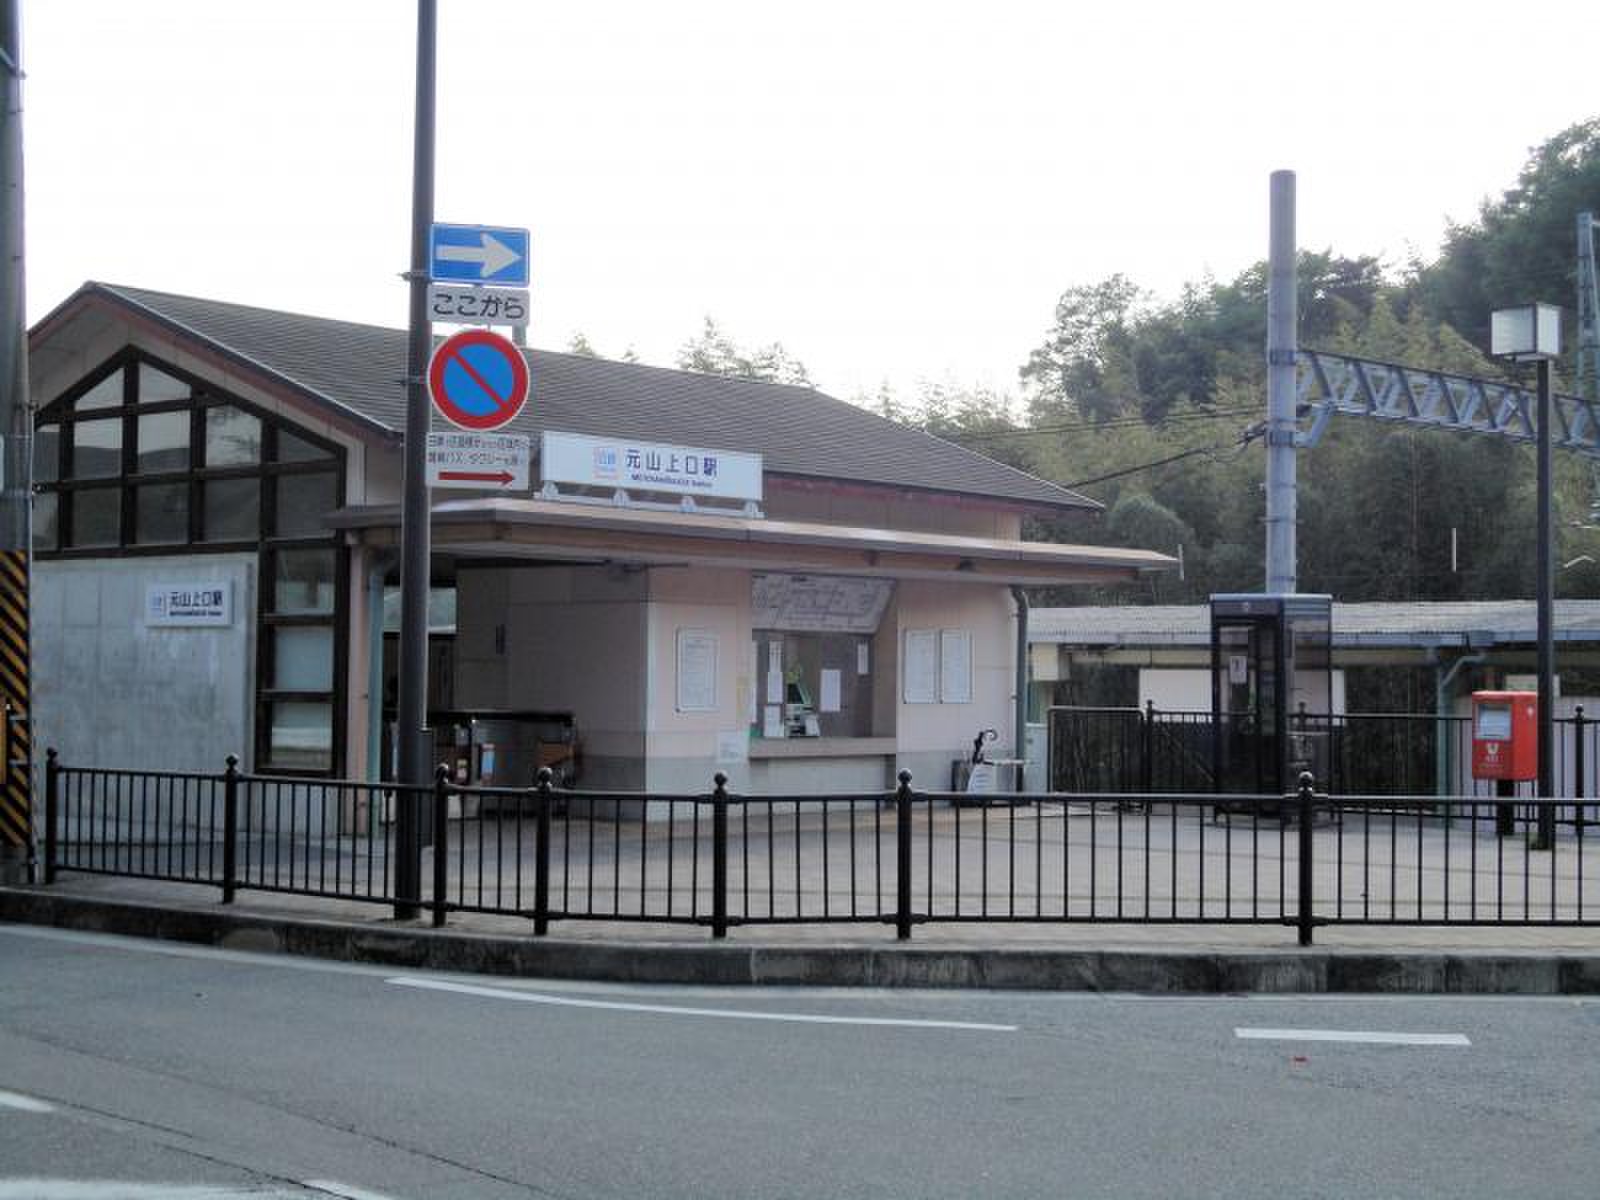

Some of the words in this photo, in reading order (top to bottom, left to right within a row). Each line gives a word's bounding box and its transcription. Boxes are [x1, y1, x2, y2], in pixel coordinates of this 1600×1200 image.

[433, 294, 525, 319] ここから
[625, 449, 717, 477] 元山上口駅
